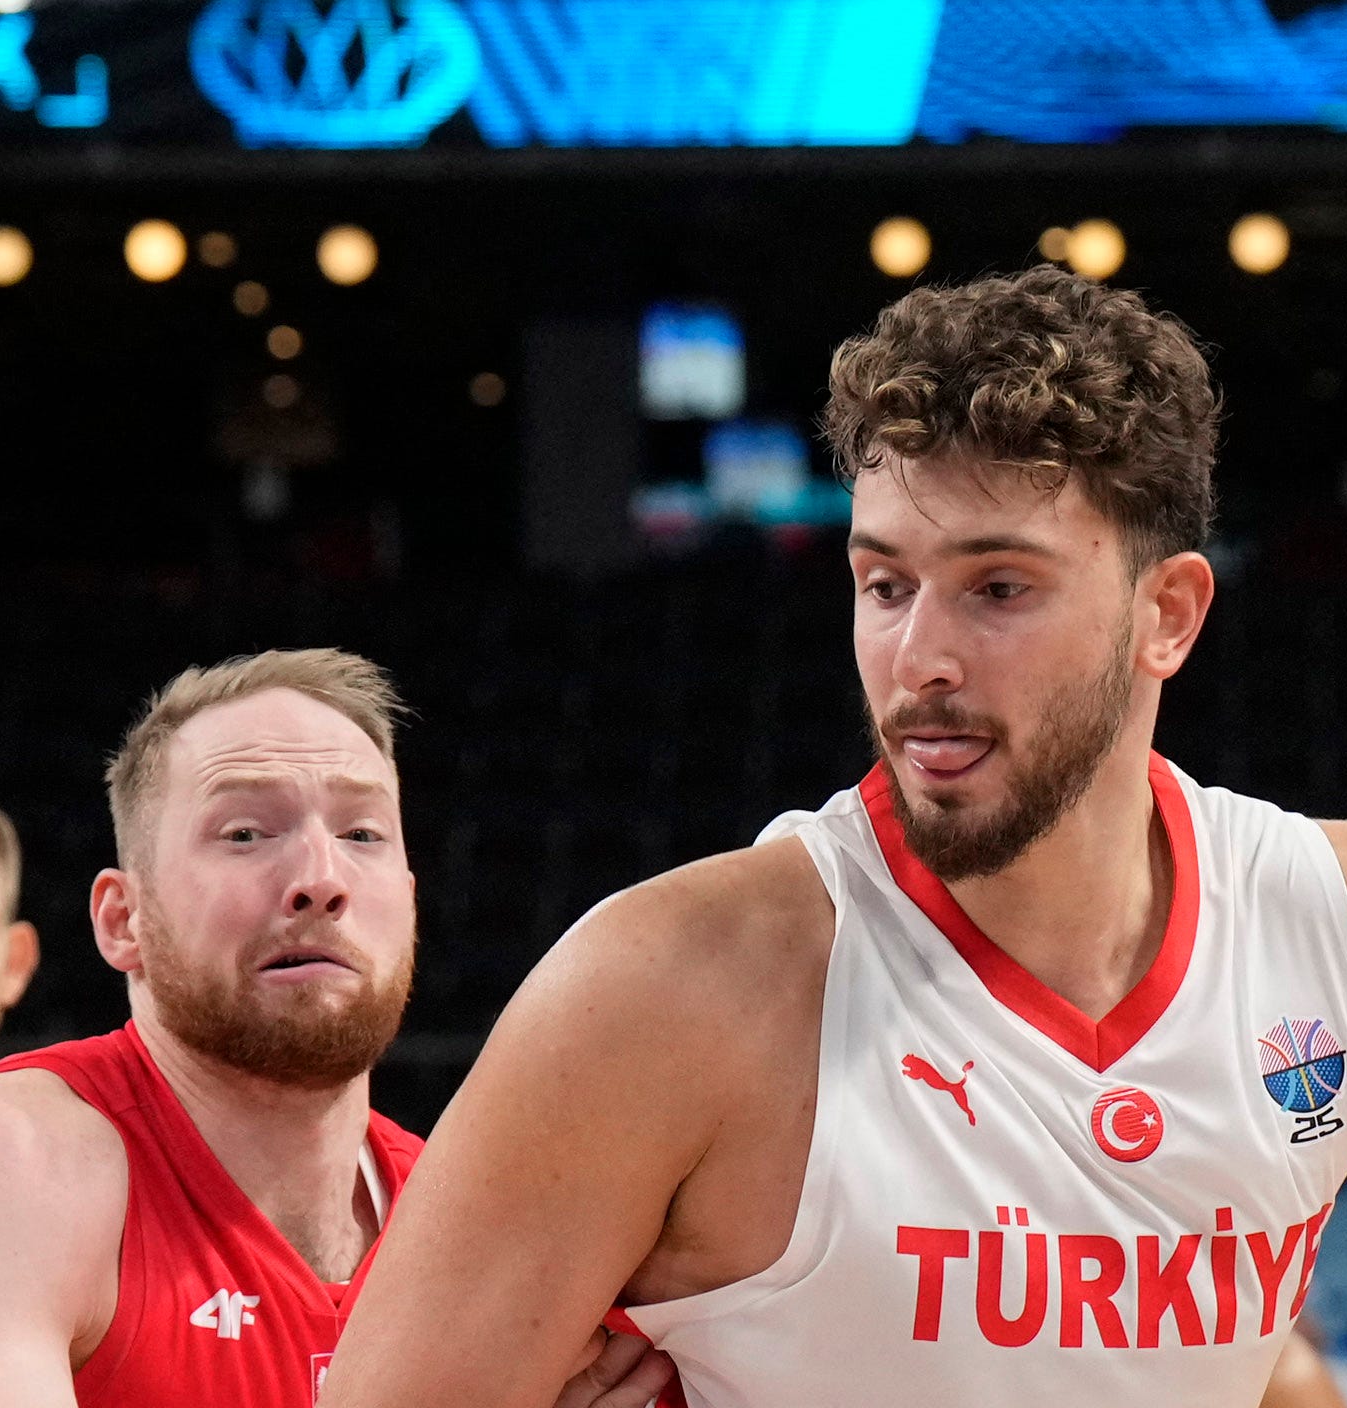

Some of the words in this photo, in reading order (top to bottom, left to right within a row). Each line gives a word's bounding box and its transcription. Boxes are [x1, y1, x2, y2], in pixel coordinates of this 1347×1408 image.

[1290, 1106, 1344, 1144] 25
[897, 1203, 1332, 1348] TÜRKİYE
[189, 1288, 261, 1340] 4F
